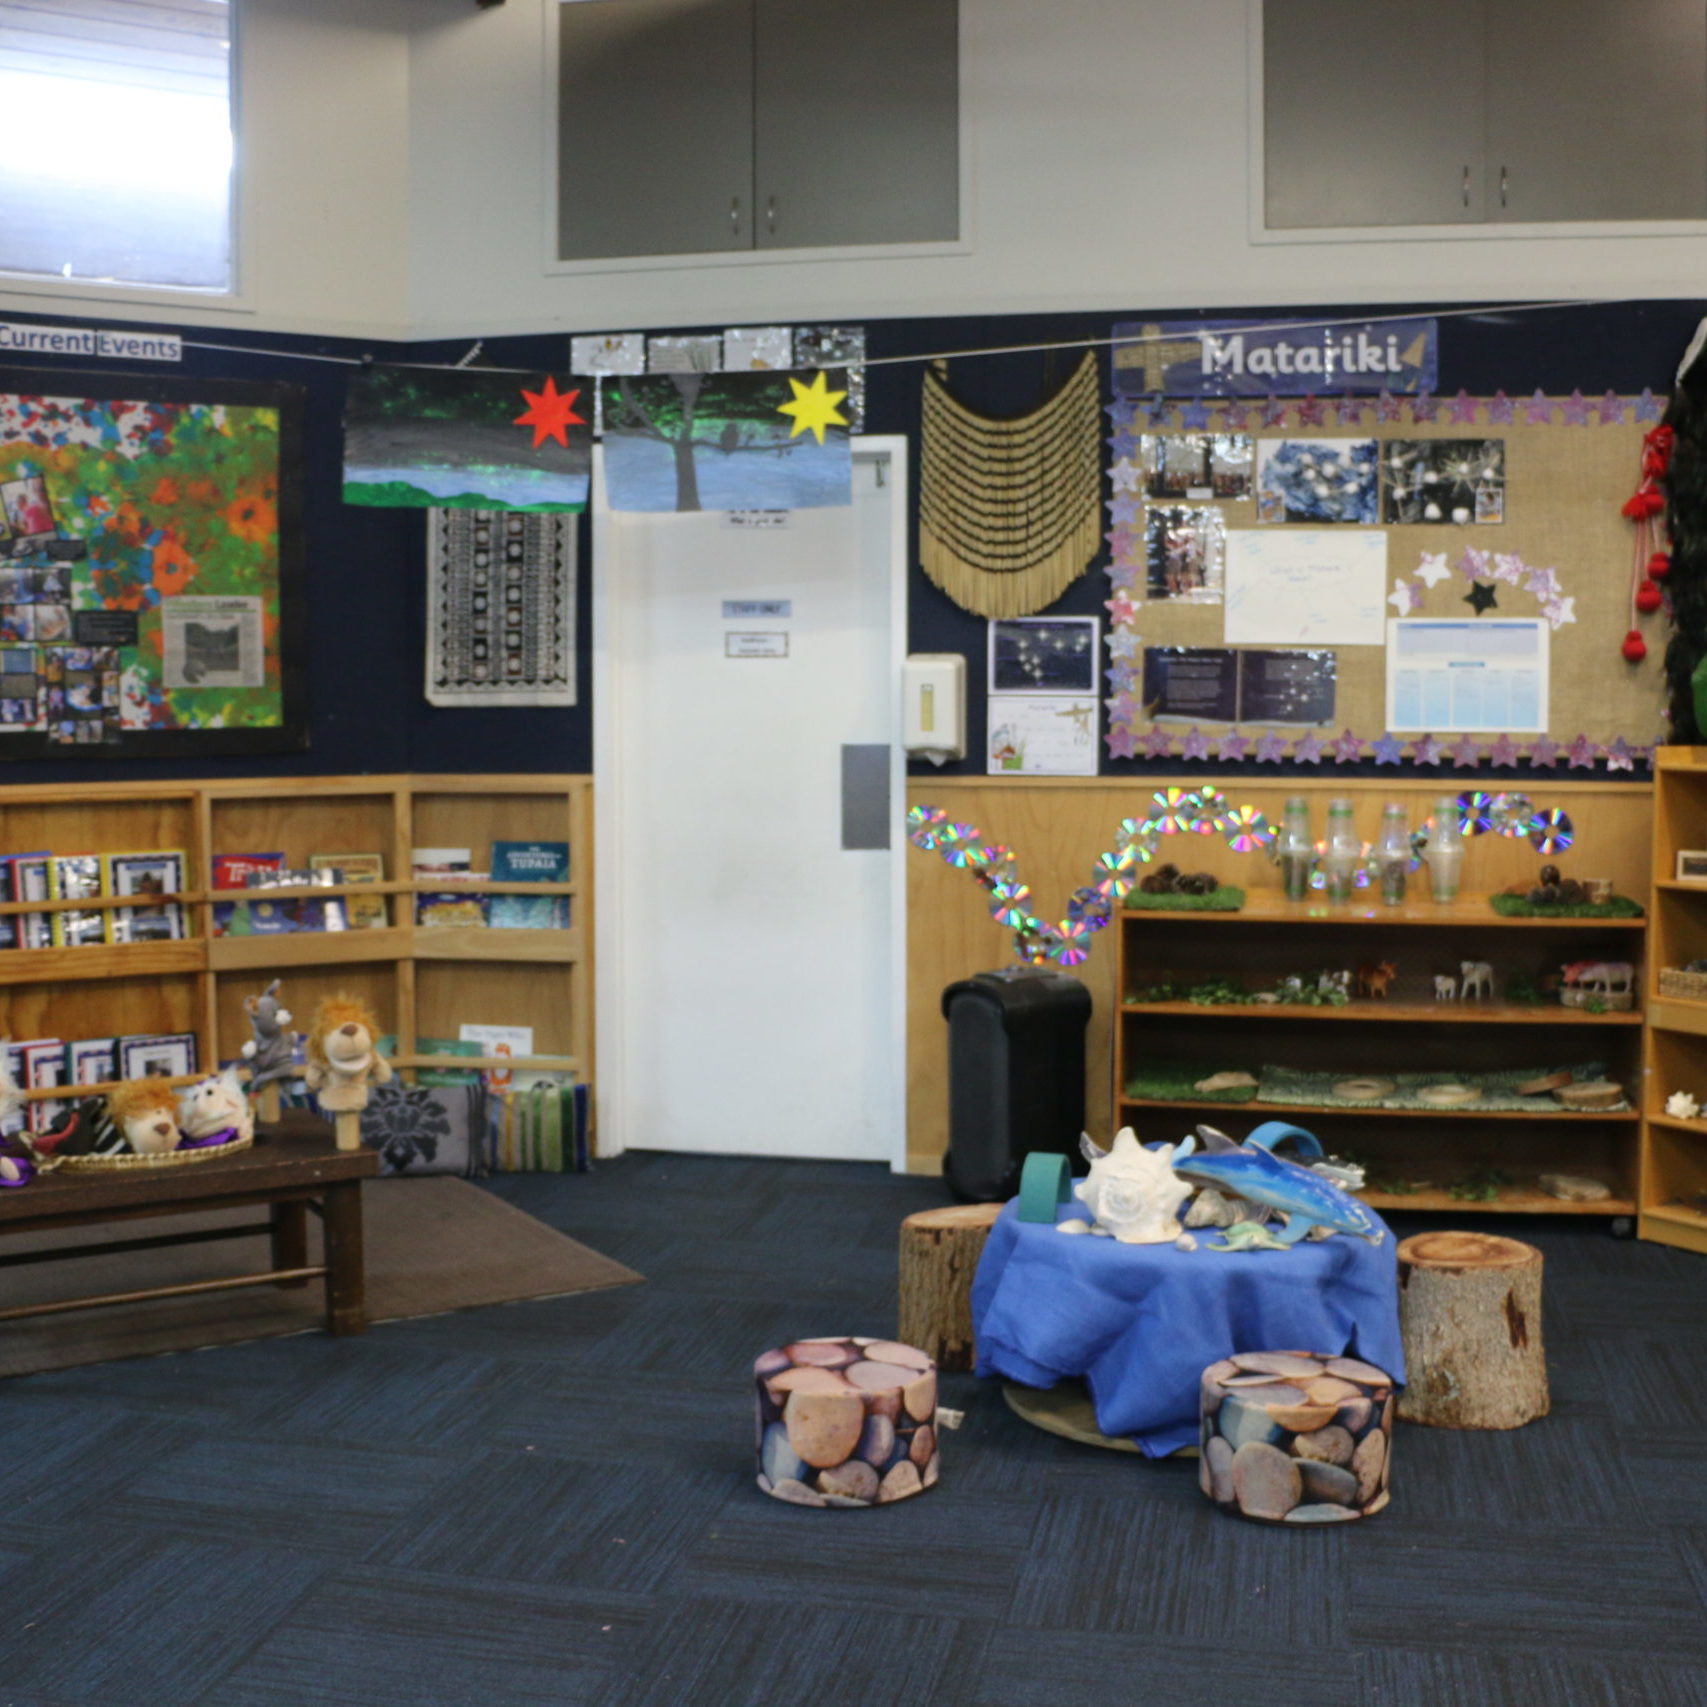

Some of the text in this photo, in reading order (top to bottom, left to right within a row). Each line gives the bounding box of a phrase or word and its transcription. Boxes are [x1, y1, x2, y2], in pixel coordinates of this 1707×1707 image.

[0, 325, 179, 358] Current Events
[1201, 333, 1402, 375] Matariki
